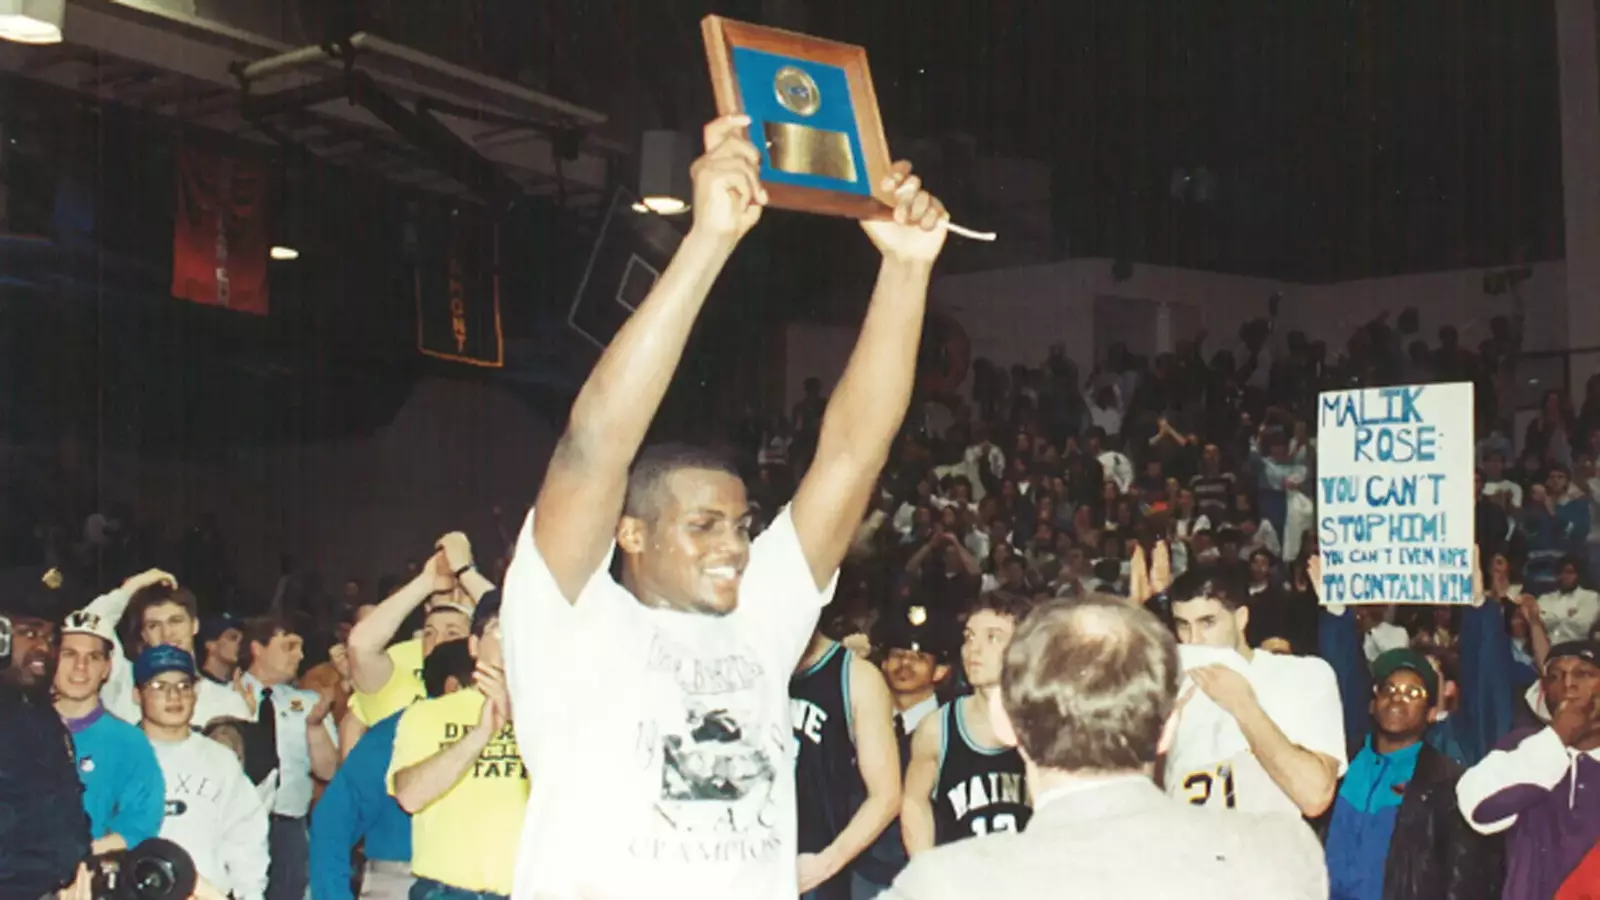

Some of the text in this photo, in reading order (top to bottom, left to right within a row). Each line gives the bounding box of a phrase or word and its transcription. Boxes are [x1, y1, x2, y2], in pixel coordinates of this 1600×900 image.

[1321, 385, 1425, 428] MALIK
[1319, 473, 1446, 508] YOU CAN'T
[1321, 549, 1344, 567] YOU
[1399, 547, 1435, 566] EVEN
[1439, 547, 1469, 568] HOPE
[1321, 572, 1473, 602] TO CONTAIN HIM
[946, 771, 1022, 821] MAIN
